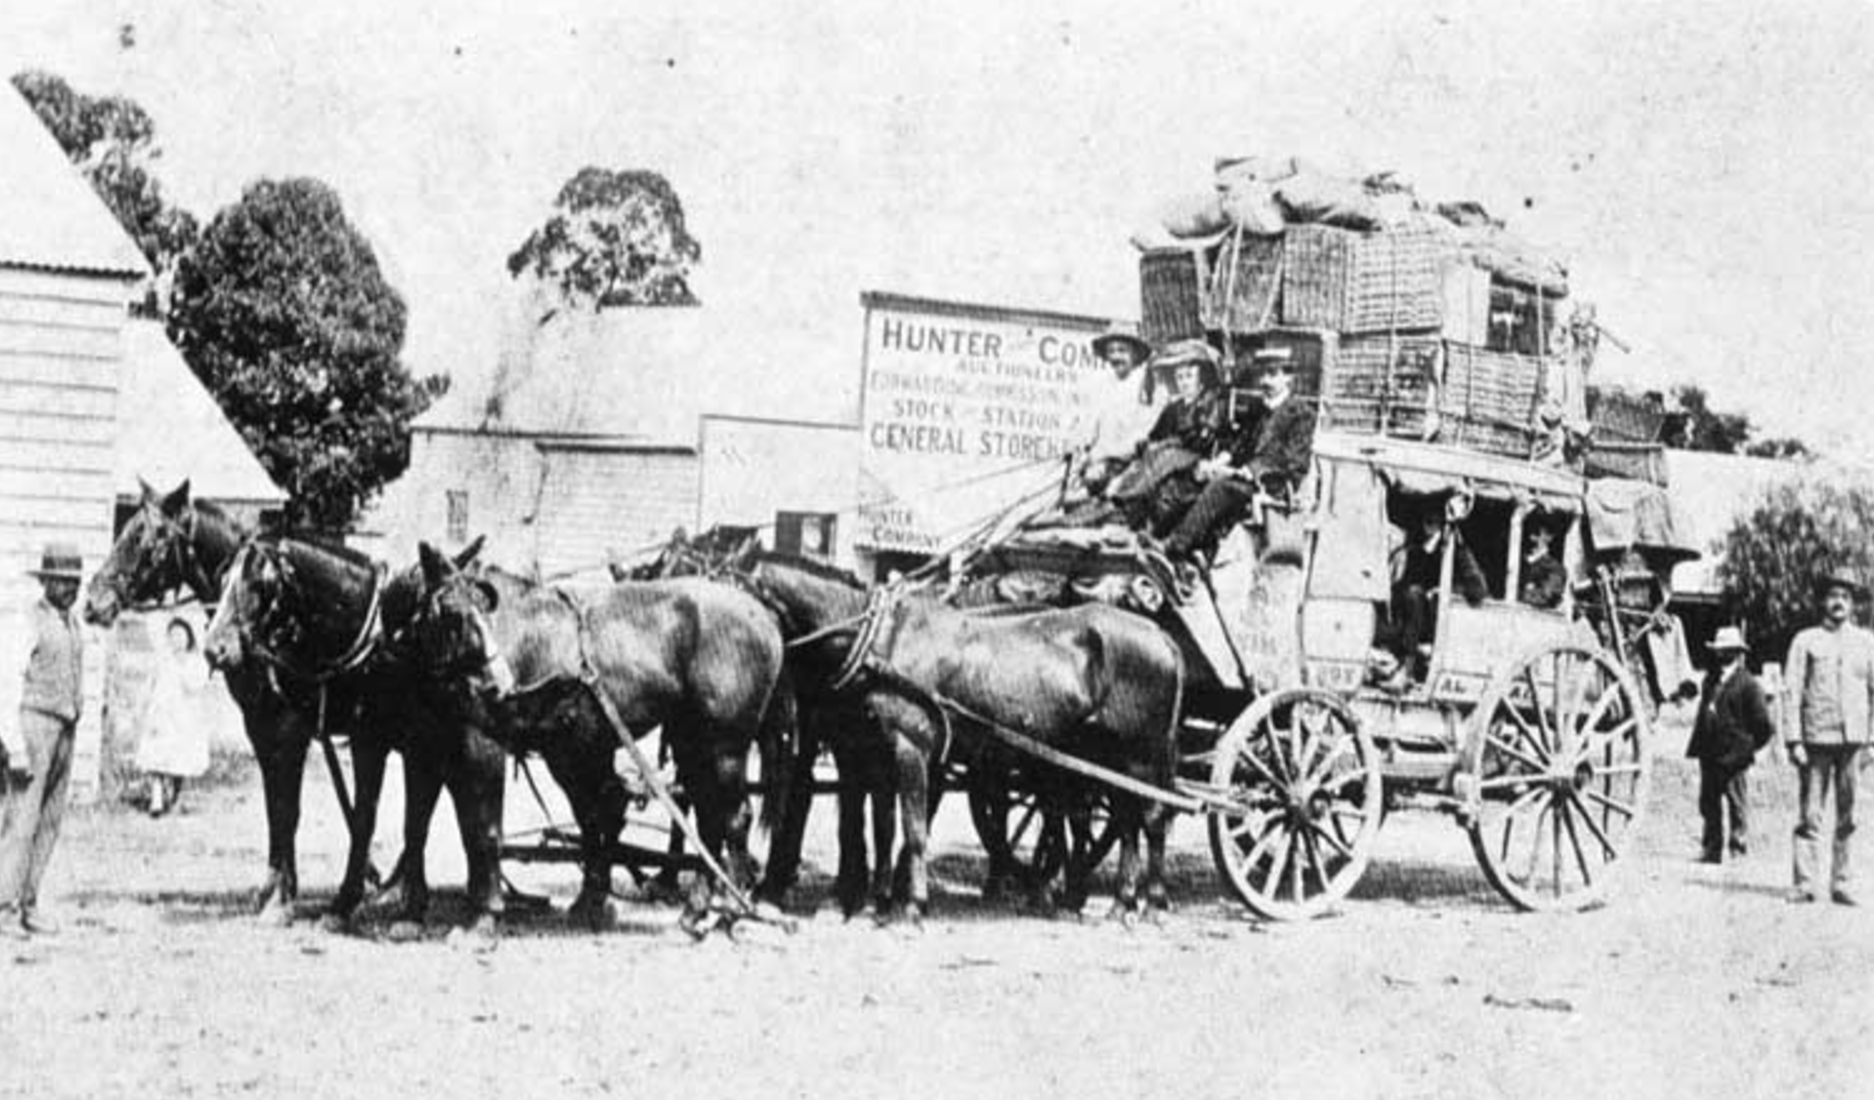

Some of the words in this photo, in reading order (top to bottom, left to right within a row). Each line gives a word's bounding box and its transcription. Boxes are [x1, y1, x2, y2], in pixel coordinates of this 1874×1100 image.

[882, 318, 1002, 359] HUNTER
[893, 398, 954, 421] STOCK
[980, 405, 1060, 430] STATION
[870, 422, 967, 454] GENERAL
